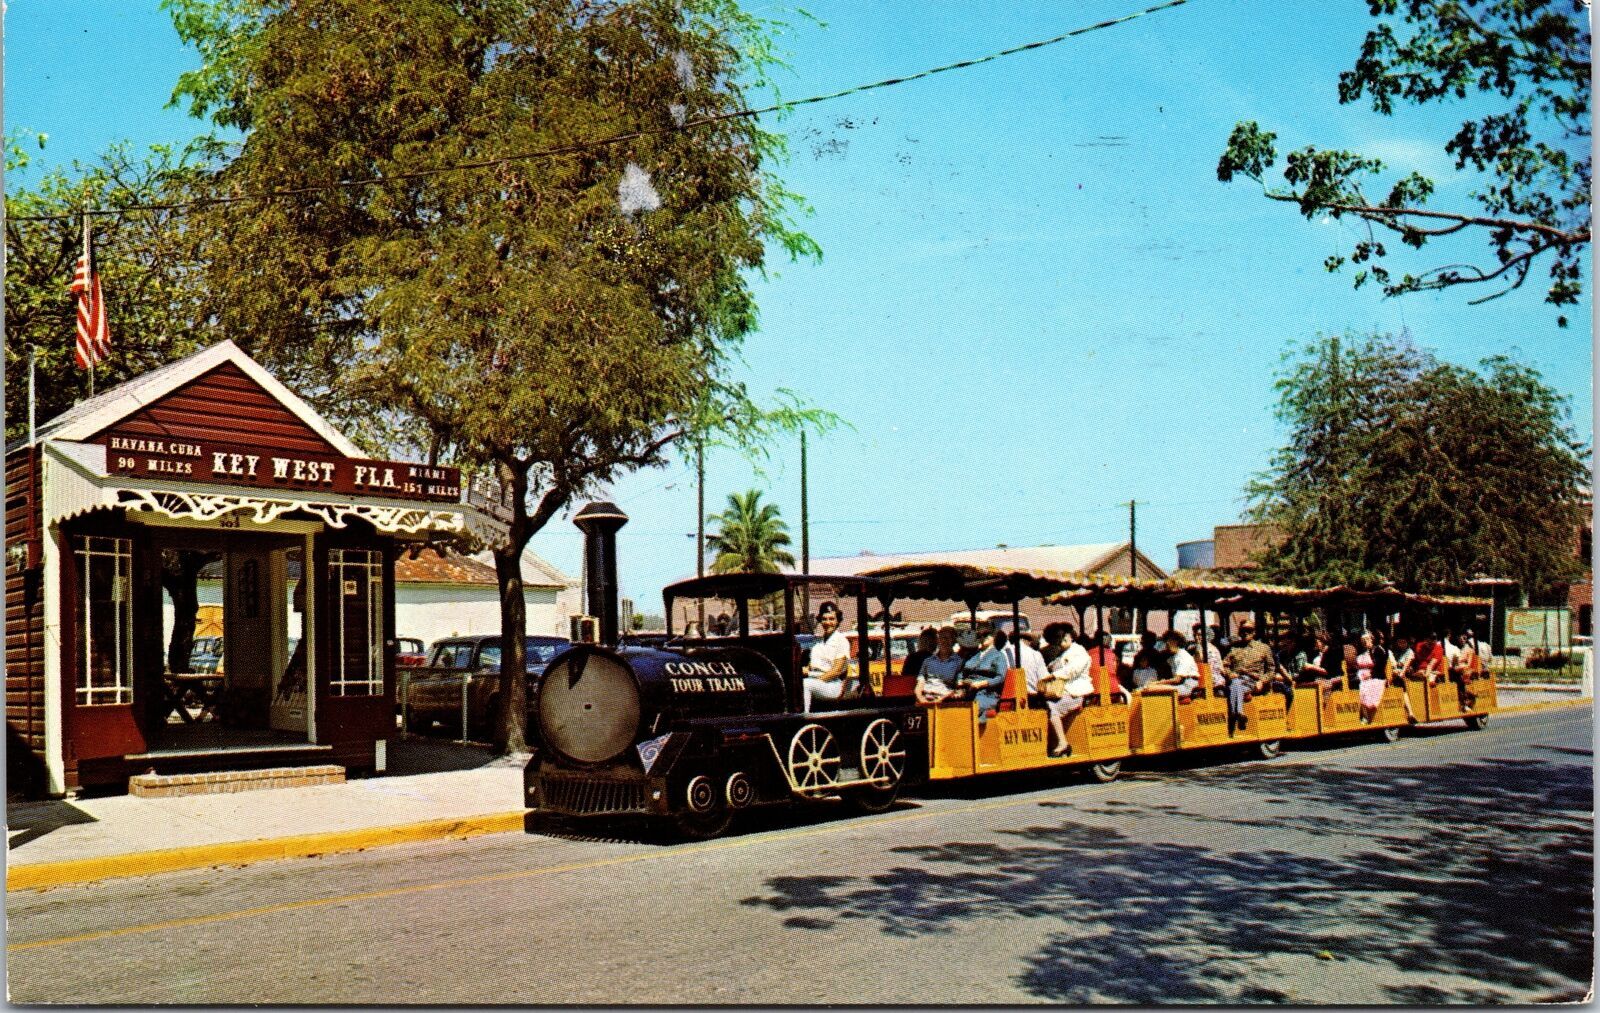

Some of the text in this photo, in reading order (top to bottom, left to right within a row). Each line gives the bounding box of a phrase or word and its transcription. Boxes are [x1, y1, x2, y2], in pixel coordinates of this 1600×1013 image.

[169, 443, 202, 456] CUBA
[118, 457, 192, 474] 90 MILES
[212, 452, 402, 489] KEY WEST FLA.
[409, 467, 446, 480] MIAMI
[404, 482, 459, 496] 157 MILES
[665, 662, 737, 675] CONCH
[670, 677, 746, 692] TOUR TRAIN
[907, 716, 922, 729] 97
[1003, 728, 1043, 745] KEY WEST
